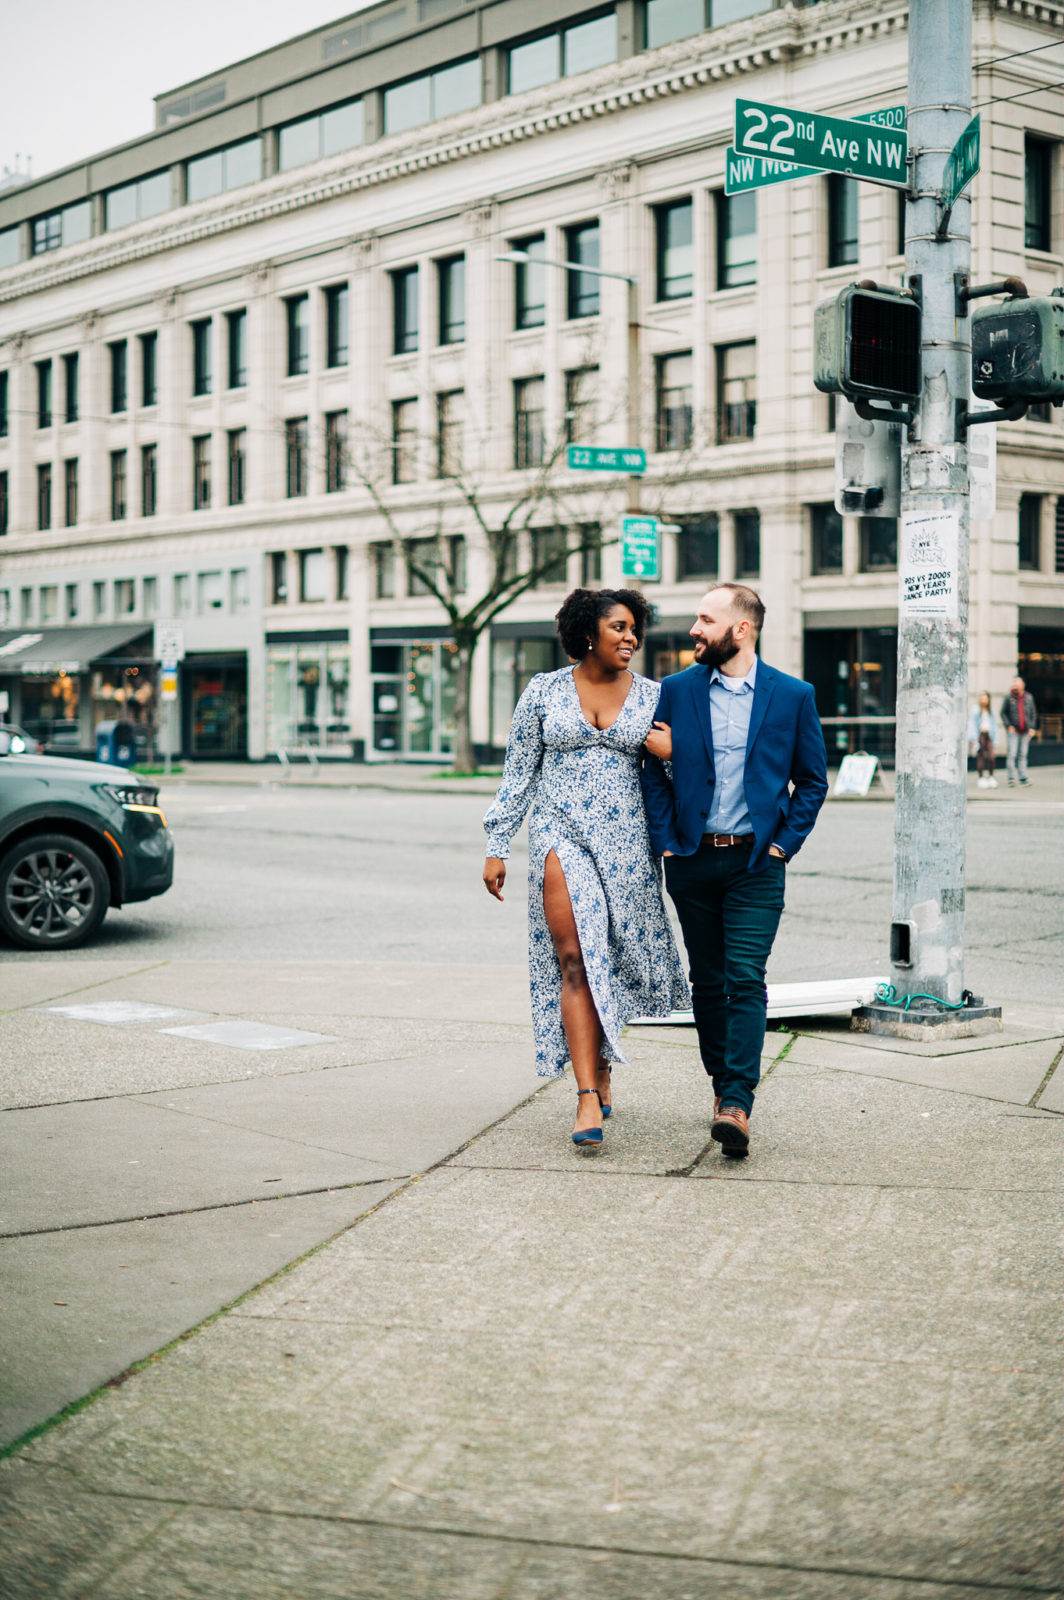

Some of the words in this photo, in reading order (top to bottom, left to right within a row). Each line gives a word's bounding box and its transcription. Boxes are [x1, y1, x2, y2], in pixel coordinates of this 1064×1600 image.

[870, 109, 903, 127] 5500
[742, 107, 815, 156] 22nd
[820, 129, 860, 162] Ave
[867, 137, 903, 170] NW
[729, 157, 755, 185] NW
[574, 451, 591, 465] 22
[917, 575, 926, 583] VS
[928, 572, 951, 581] 2000S
[908, 584, 920, 592] NEW
[923, 580, 946, 590] YEARS
[925, 588, 952, 597] PARTY!
